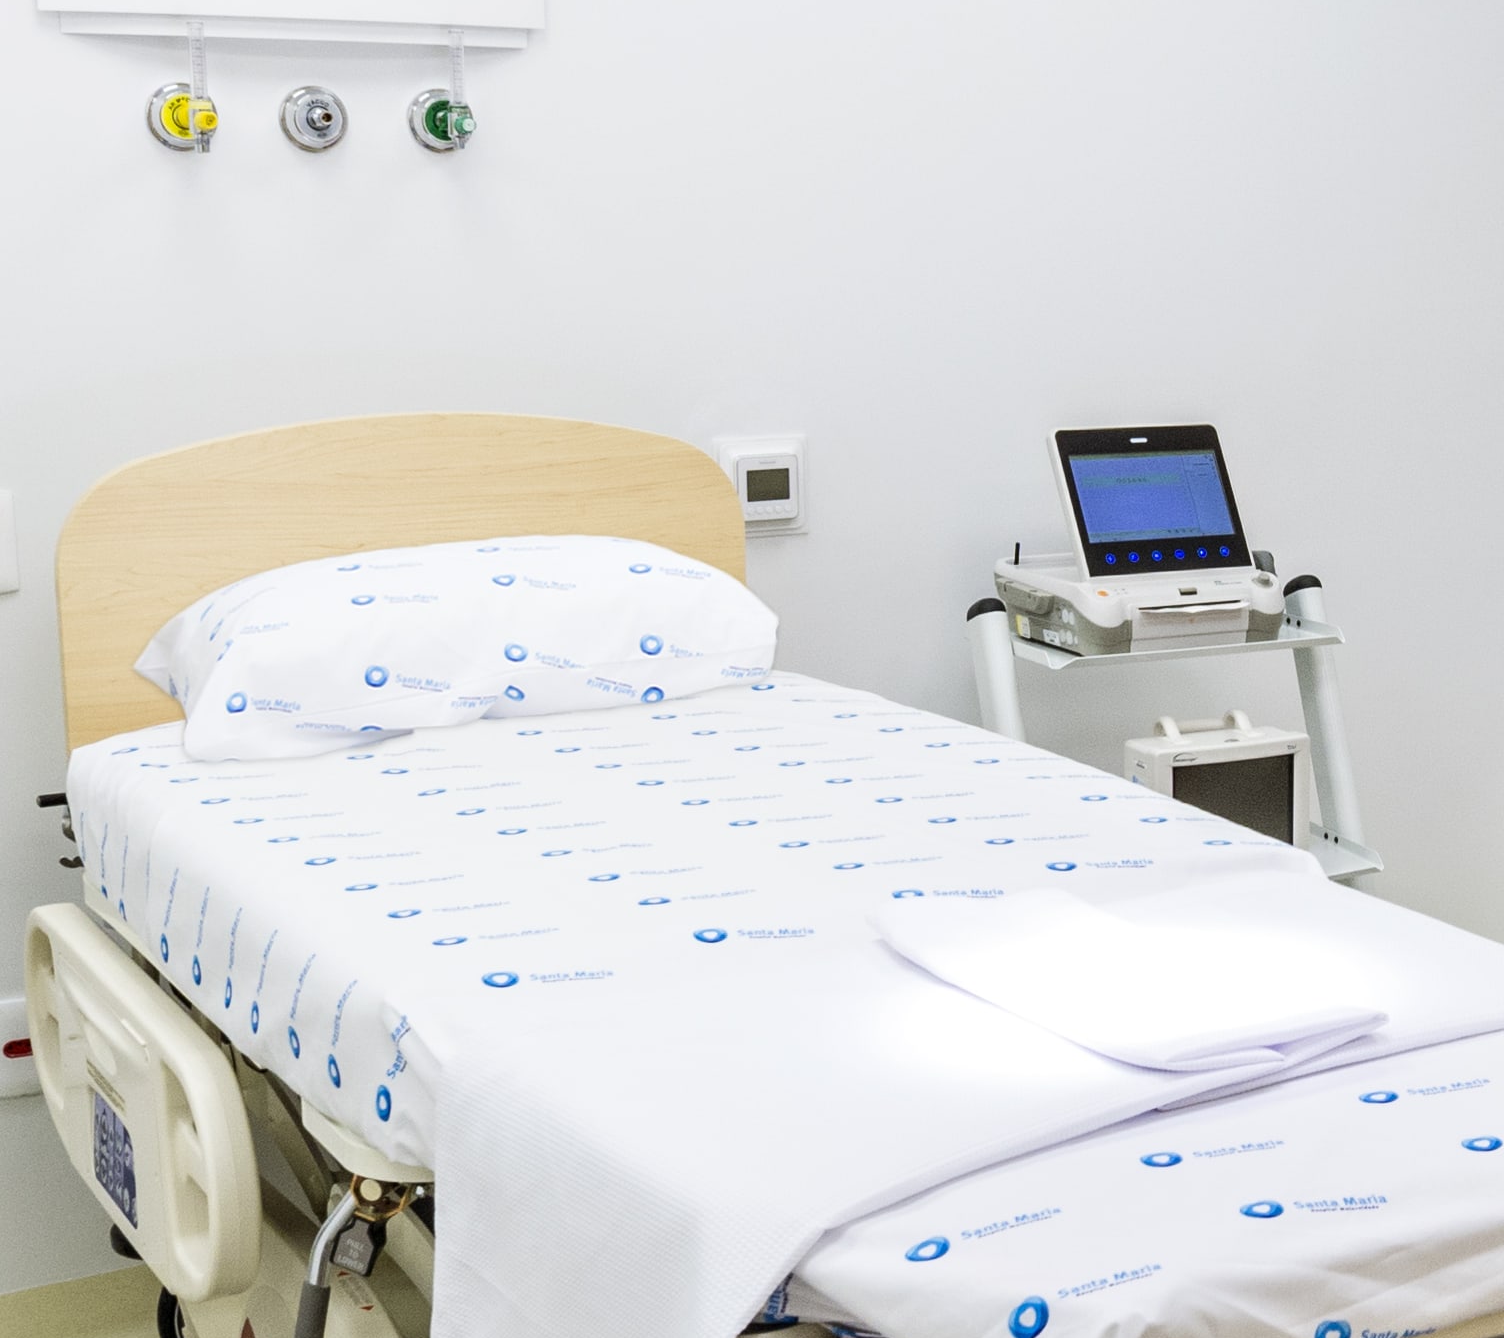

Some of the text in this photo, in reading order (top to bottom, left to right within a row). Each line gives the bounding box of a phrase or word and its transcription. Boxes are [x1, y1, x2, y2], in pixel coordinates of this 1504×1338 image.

[395, 673, 452, 691] Santa Maria
[274, 699, 302, 712] Maria
[970, 887, 1004, 896] Maria
[736, 926, 815, 937] Santa Maria
[529, 969, 614, 982] Santa Maria
[1407, 1076, 1491, 1095] Santa Maria
[1192, 1138, 1285, 1158] Santa Maria
[1293, 1193, 1388, 1209] Santa Maria
[961, 1207, 1062, 1240] Santa Maria
[1057, 1263, 1162, 1299] Santa Maria
